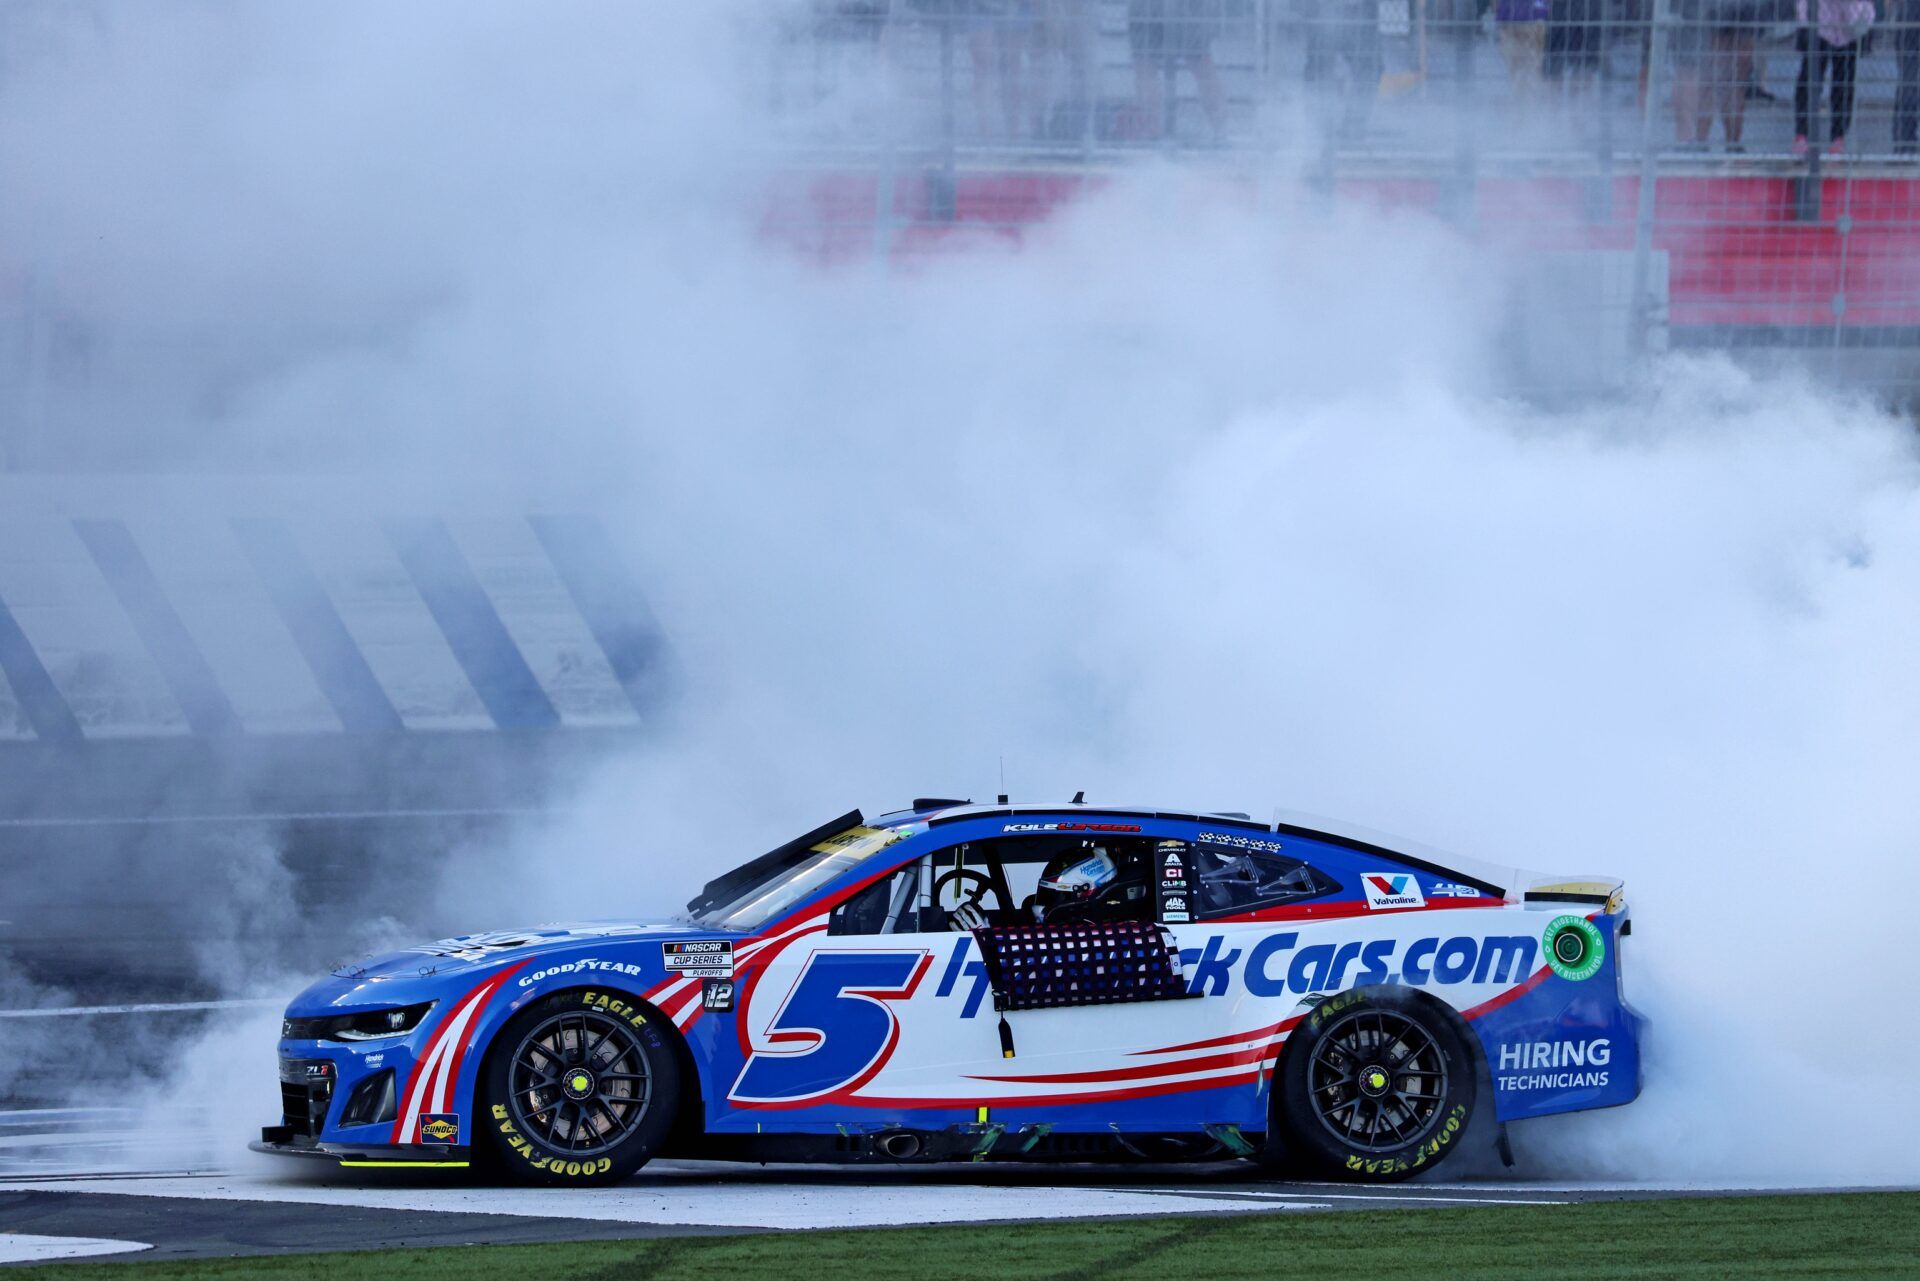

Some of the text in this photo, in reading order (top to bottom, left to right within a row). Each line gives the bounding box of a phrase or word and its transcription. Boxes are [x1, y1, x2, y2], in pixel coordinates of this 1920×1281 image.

[1373, 896, 1418, 905] Valvoline
[1544, 915, 1598, 942] GET BIOETHANOL
[673, 955, 723, 965] CUP SERIES
[684, 943, 722, 952] NASCAR
[518, 958, 641, 987] GOODYEAR
[1550, 955, 1603, 980] GET BIOETHANOL
[710, 983, 733, 1008] 12
[582, 991, 648, 1029] EAGLE
[727, 949, 935, 1109] 5
[1499, 1038, 1611, 1071] HIRING
[1498, 1071, 1609, 1091] TECHNICIANS
[423, 1124, 458, 1135] SUNOCO
[491, 1103, 612, 1176] GOODYEAR
